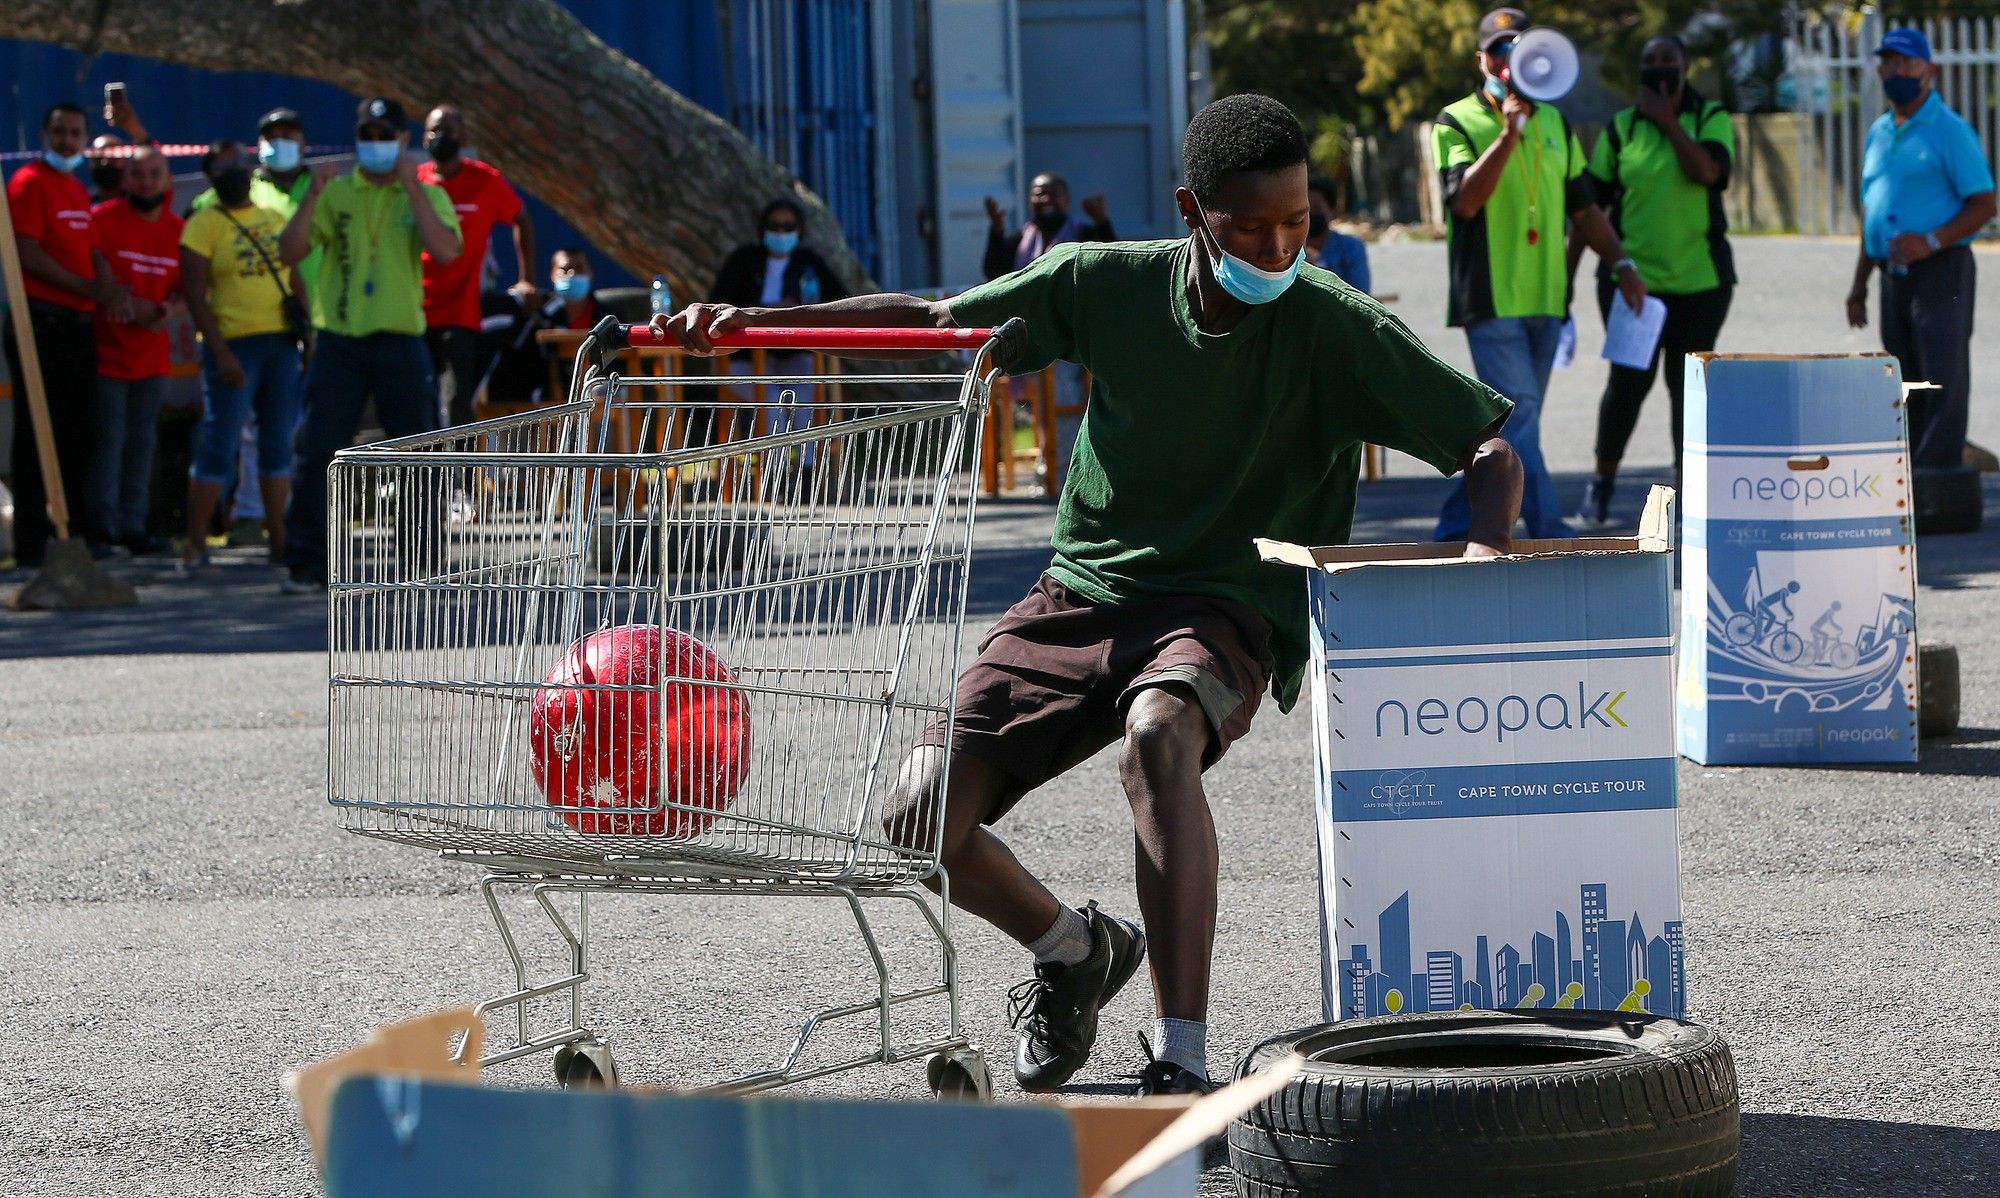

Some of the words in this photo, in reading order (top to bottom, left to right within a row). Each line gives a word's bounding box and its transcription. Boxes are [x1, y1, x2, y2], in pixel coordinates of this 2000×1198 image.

[1732, 468, 1872, 507] neopak
[1779, 532, 1804, 541] CAPE
[1807, 531, 1835, 540] TOWN
[1836, 529, 1866, 539] CYCLE
[1867, 527, 1892, 537] TOUR
[1375, 680, 1612, 743] neopak
[1826, 724, 1896, 744] neopak
[1370, 783, 1437, 800] CTCTT
[1458, 785, 1497, 799] CAPE
[1501, 783, 1548, 797] TOWN
[1552, 782, 1600, 796] CYCLE
[1604, 780, 1646, 793] TOUR
